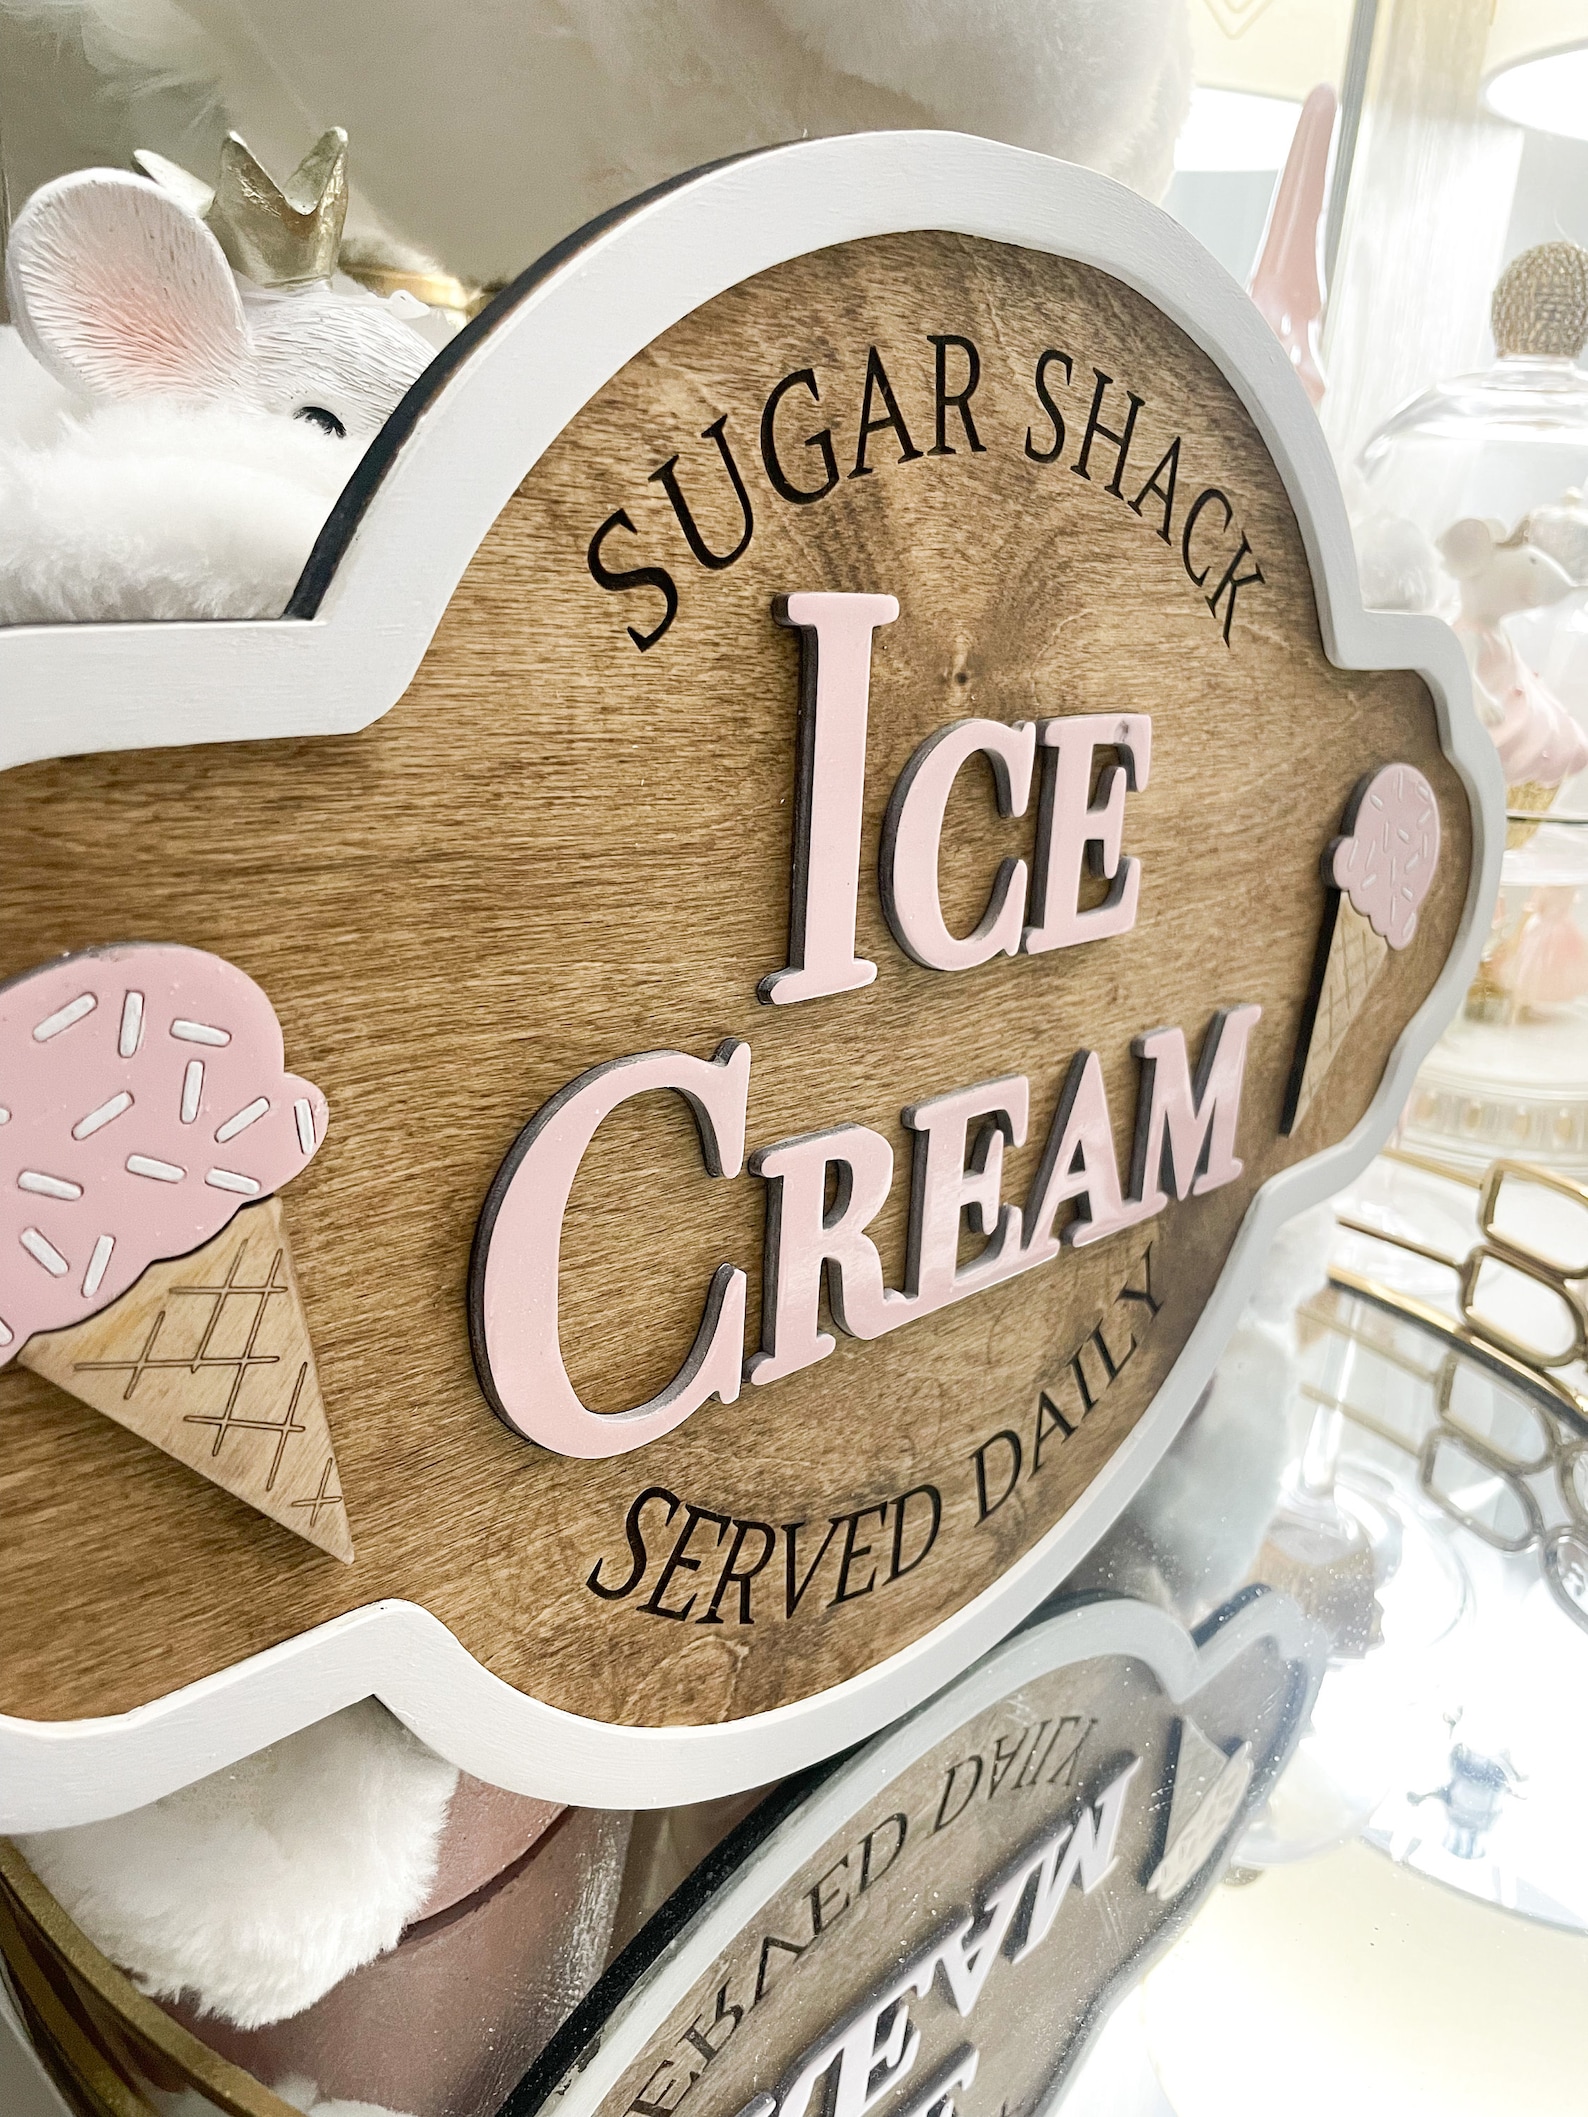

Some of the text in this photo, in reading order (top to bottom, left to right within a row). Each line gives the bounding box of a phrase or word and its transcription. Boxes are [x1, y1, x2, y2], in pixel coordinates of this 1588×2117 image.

[587, 334, 1266, 653] SUGAR SHACK
[758, 591, 1152, 1006] ICE
[467, 1004, 1262, 1460] CREAM
[585, 1241, 1166, 1626] SERVED DAILY
